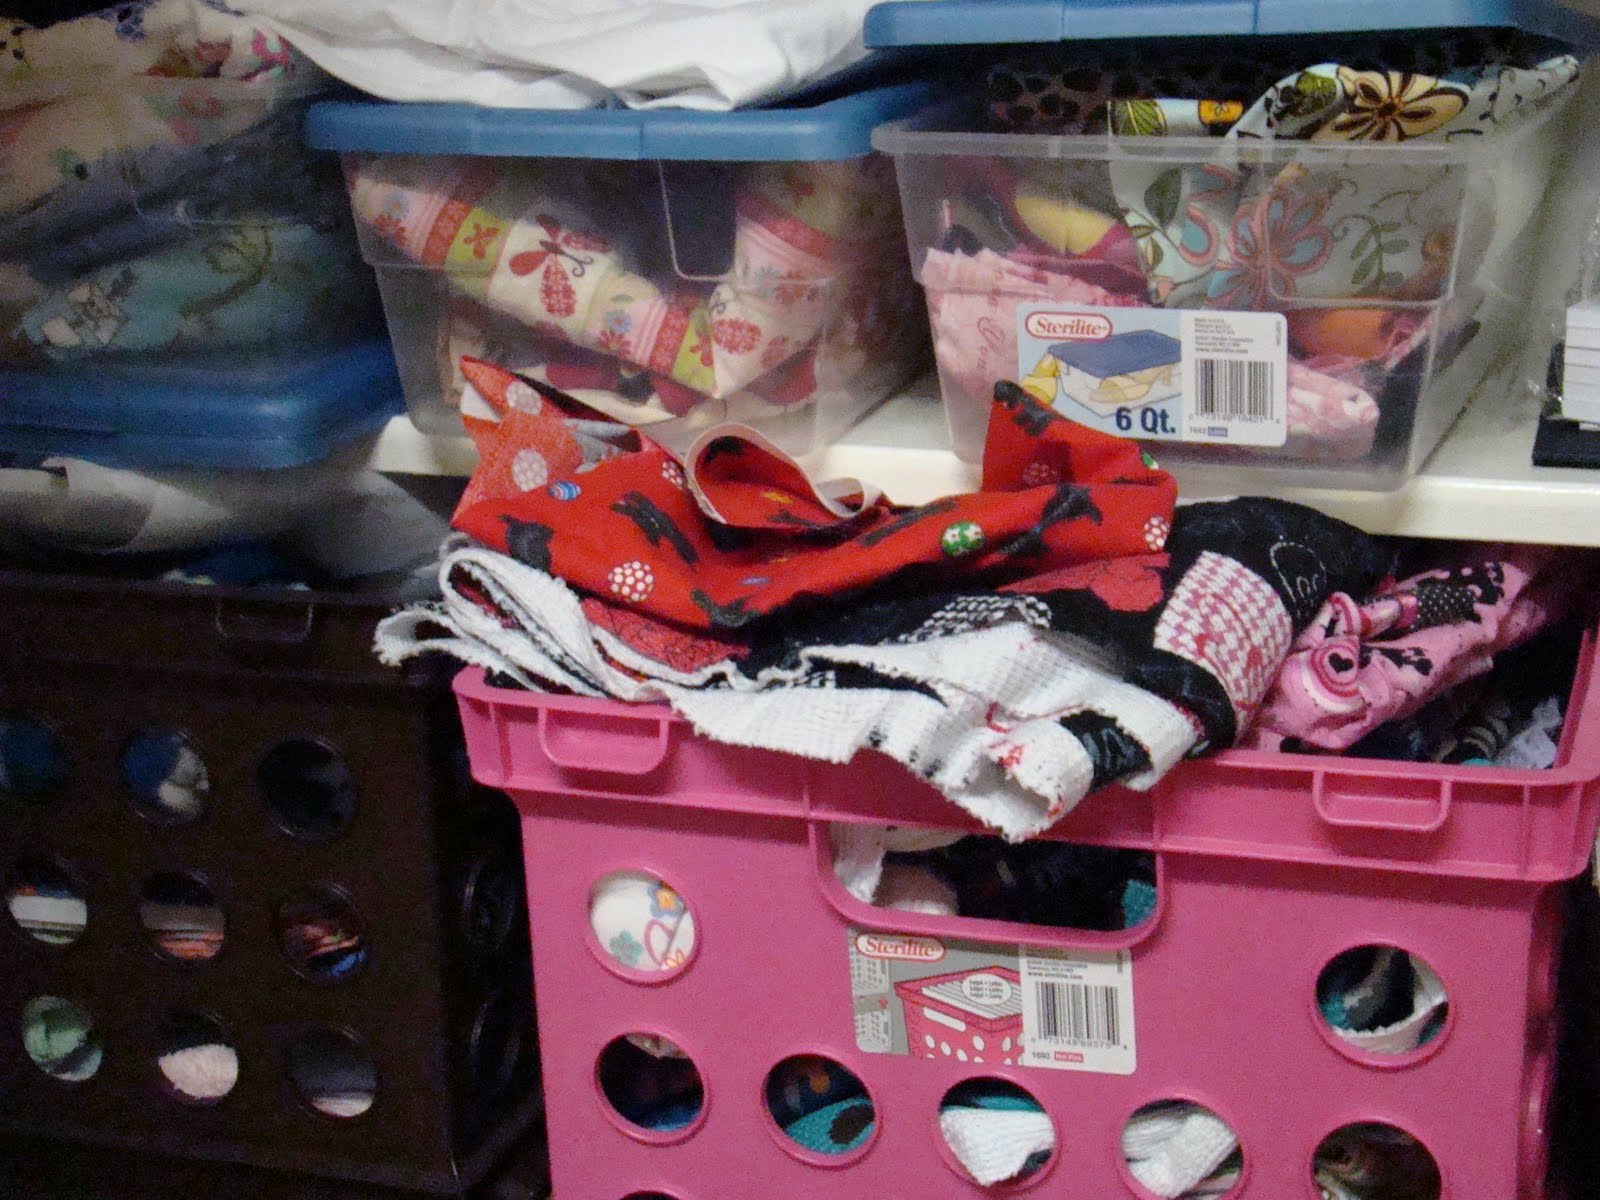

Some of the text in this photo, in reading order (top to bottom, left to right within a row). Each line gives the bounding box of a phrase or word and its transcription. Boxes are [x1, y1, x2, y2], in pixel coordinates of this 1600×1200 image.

[1035, 317, 1098, 335] Sterilite
[1115, 407, 1176, 435] 6 Qt.
[864, 936, 934, 957] Sterilite
